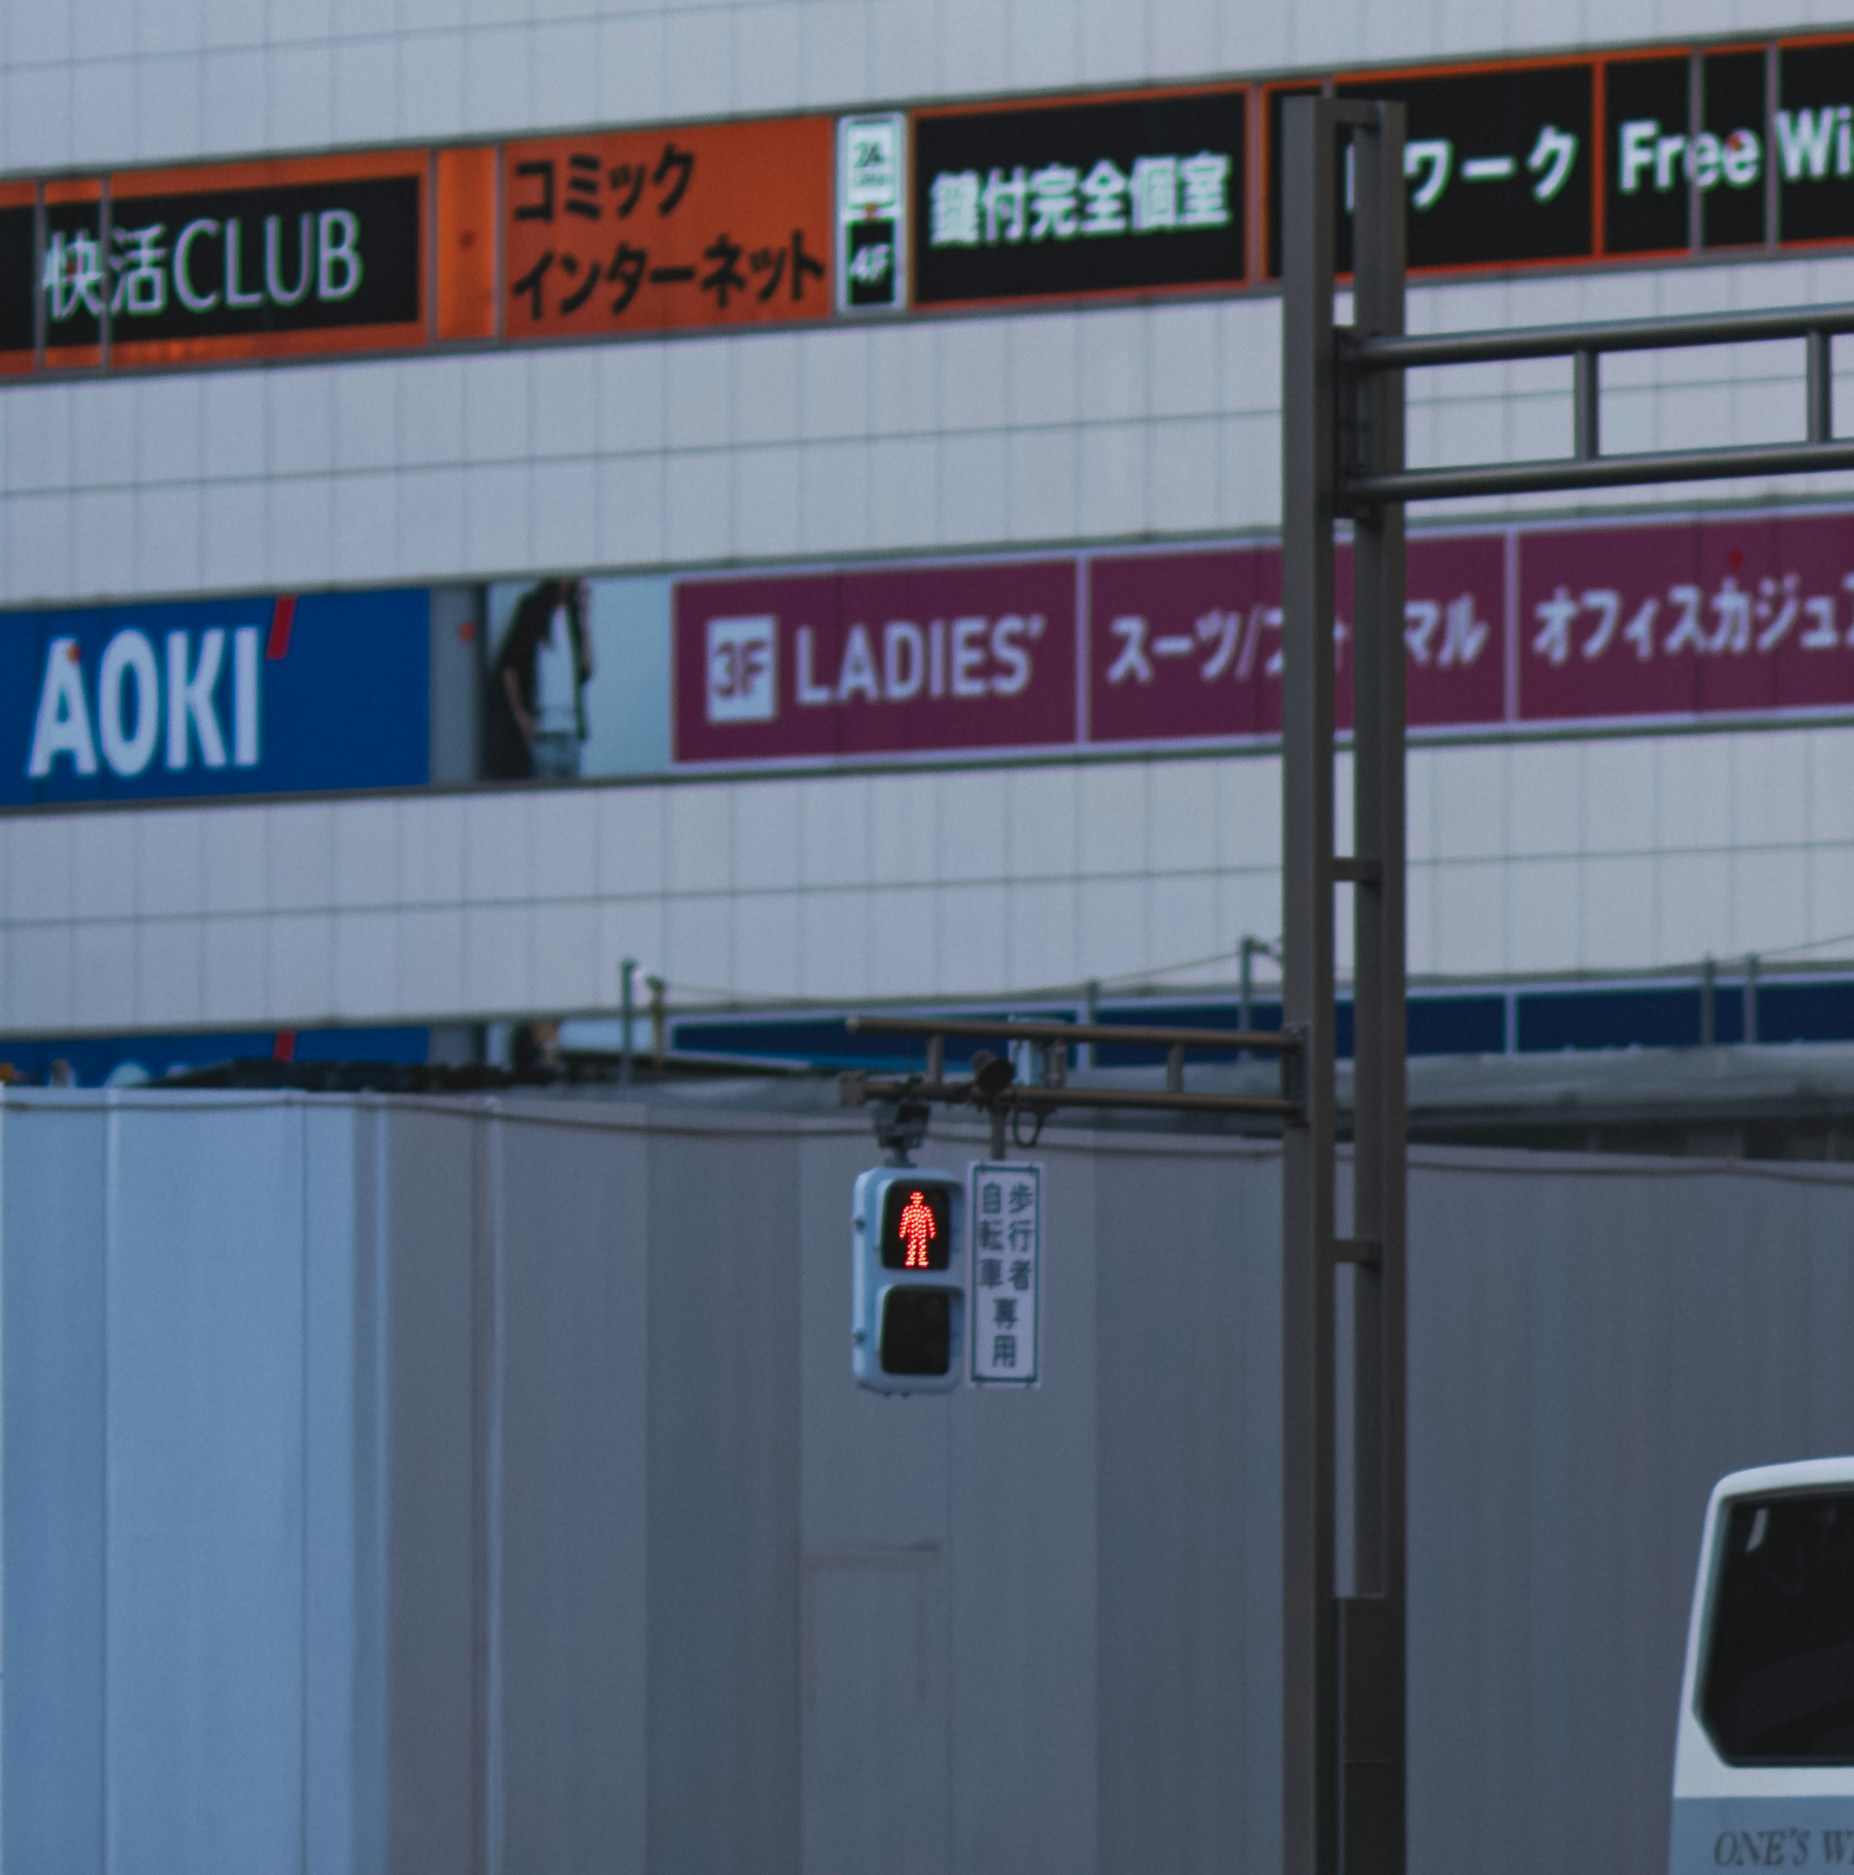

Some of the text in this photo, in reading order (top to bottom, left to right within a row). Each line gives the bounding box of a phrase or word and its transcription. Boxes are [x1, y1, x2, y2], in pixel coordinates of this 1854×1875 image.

[514, 142, 696, 223] コミック
[930, 150, 1231, 247] 鍵付完全個室
[1619, 119, 1761, 193] Free
[42, 207, 363, 321] 快活CLUB
[511, 227, 826, 321] インターネット
[26, 626, 261, 778] AOKI
[714, 638, 768, 699] 3F
[979, 1181, 1004, 1289] 自転車
[1008, 1182, 1034, 1291] 歩行者
[991, 1297, 1019, 1369] 専用
[1713, 1825, 1810, 1868] ONE'S
